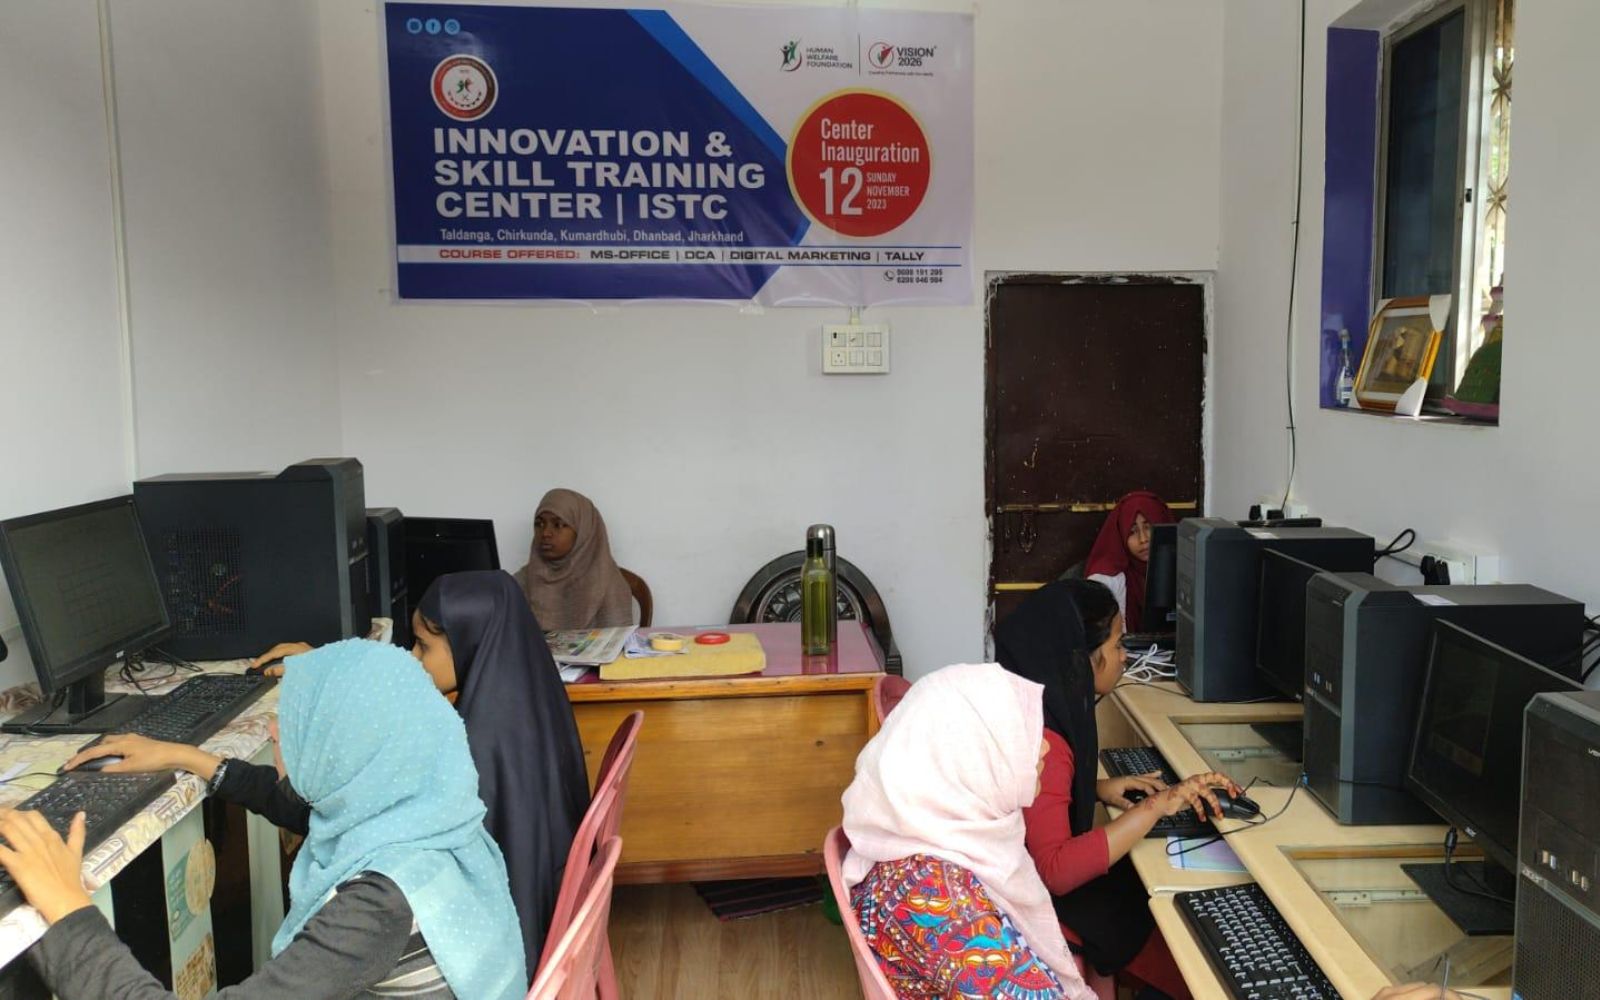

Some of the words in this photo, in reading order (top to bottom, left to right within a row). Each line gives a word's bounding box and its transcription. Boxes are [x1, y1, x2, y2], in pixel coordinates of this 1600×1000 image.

[896, 47, 934, 57] VISION
[806, 61, 853, 69] FOUNDATION
[898, 57, 922, 66] 2026
[821, 118, 874, 139] Center
[433, 127, 689, 157] INNOVATION
[704, 131, 733, 157] &
[821, 141, 919, 166] Inauguration
[434, 159, 555, 187] SKILL
[567, 161, 766, 189] TRAINING
[866, 172, 897, 182] SUNDAY
[819, 167, 863, 215] 12
[866, 185, 910, 197] NOVEMBER
[435, 191, 603, 219] CENTER
[638, 193, 728, 220] ISTC
[866, 199, 887, 209] 2023
[440, 228, 494, 243] Taldanga,
[497, 228, 558, 242] Chirkunda,
[560, 229, 630, 242] Kumardhubi,
[633, 230, 685, 243] Dhanbad,
[688, 231, 744, 242] Jharkhand
[439, 249, 502, 259] COURSE
[507, 249, 580, 259] OFFERED:
[590, 250, 671, 260] MS-OFFICE
[684, 250, 716, 260] DCA
[730, 251, 783, 260] DIGITAL
[787, 251, 871, 261] MARKETING
[884, 251, 925, 261] TALLY
